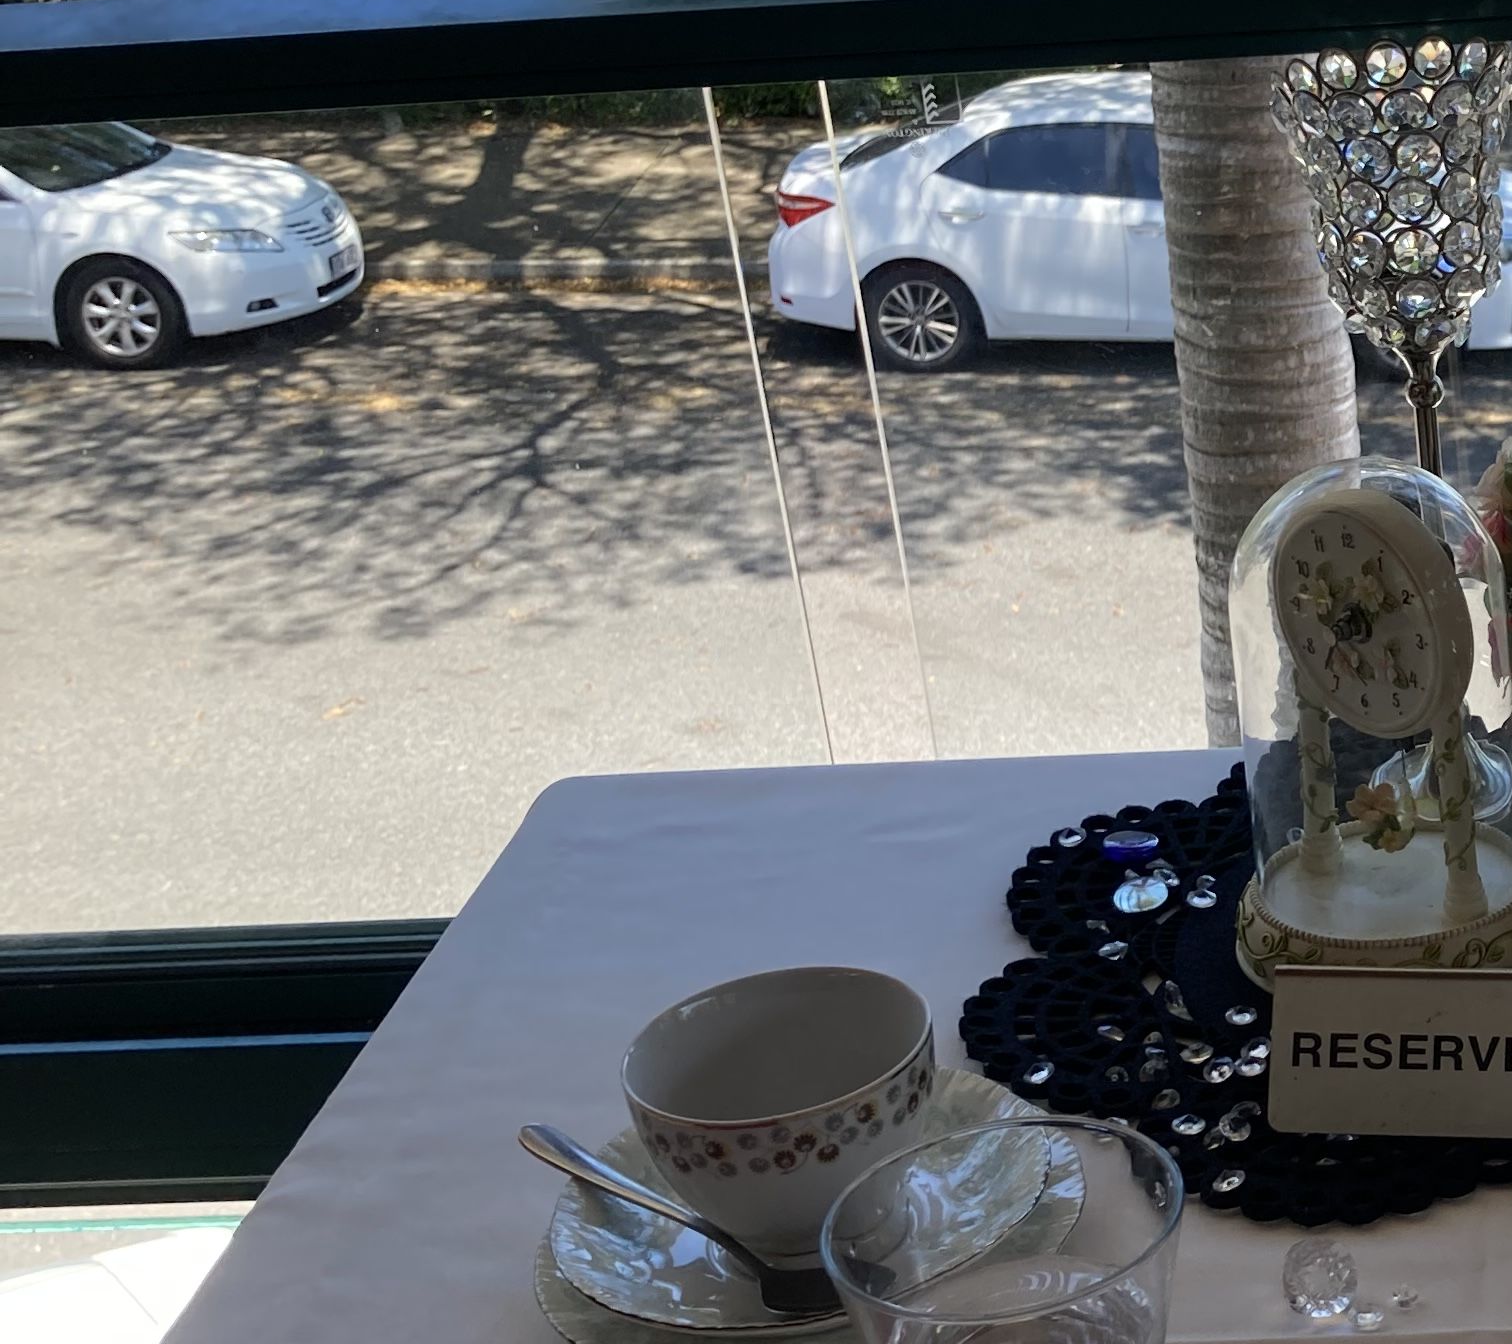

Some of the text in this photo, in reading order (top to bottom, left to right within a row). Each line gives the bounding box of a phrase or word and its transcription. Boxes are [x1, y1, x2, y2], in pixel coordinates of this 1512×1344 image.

[1314, 533, 1355, 552] 11 12
[1295, 557, 1383, 578] 10 1
[1401, 589, 1411, 605] 2
[1306, 633, 1425, 654] 8 3
[1332, 671, 1418, 690] 7 4
[1360, 692, 1401, 708] 6 5
